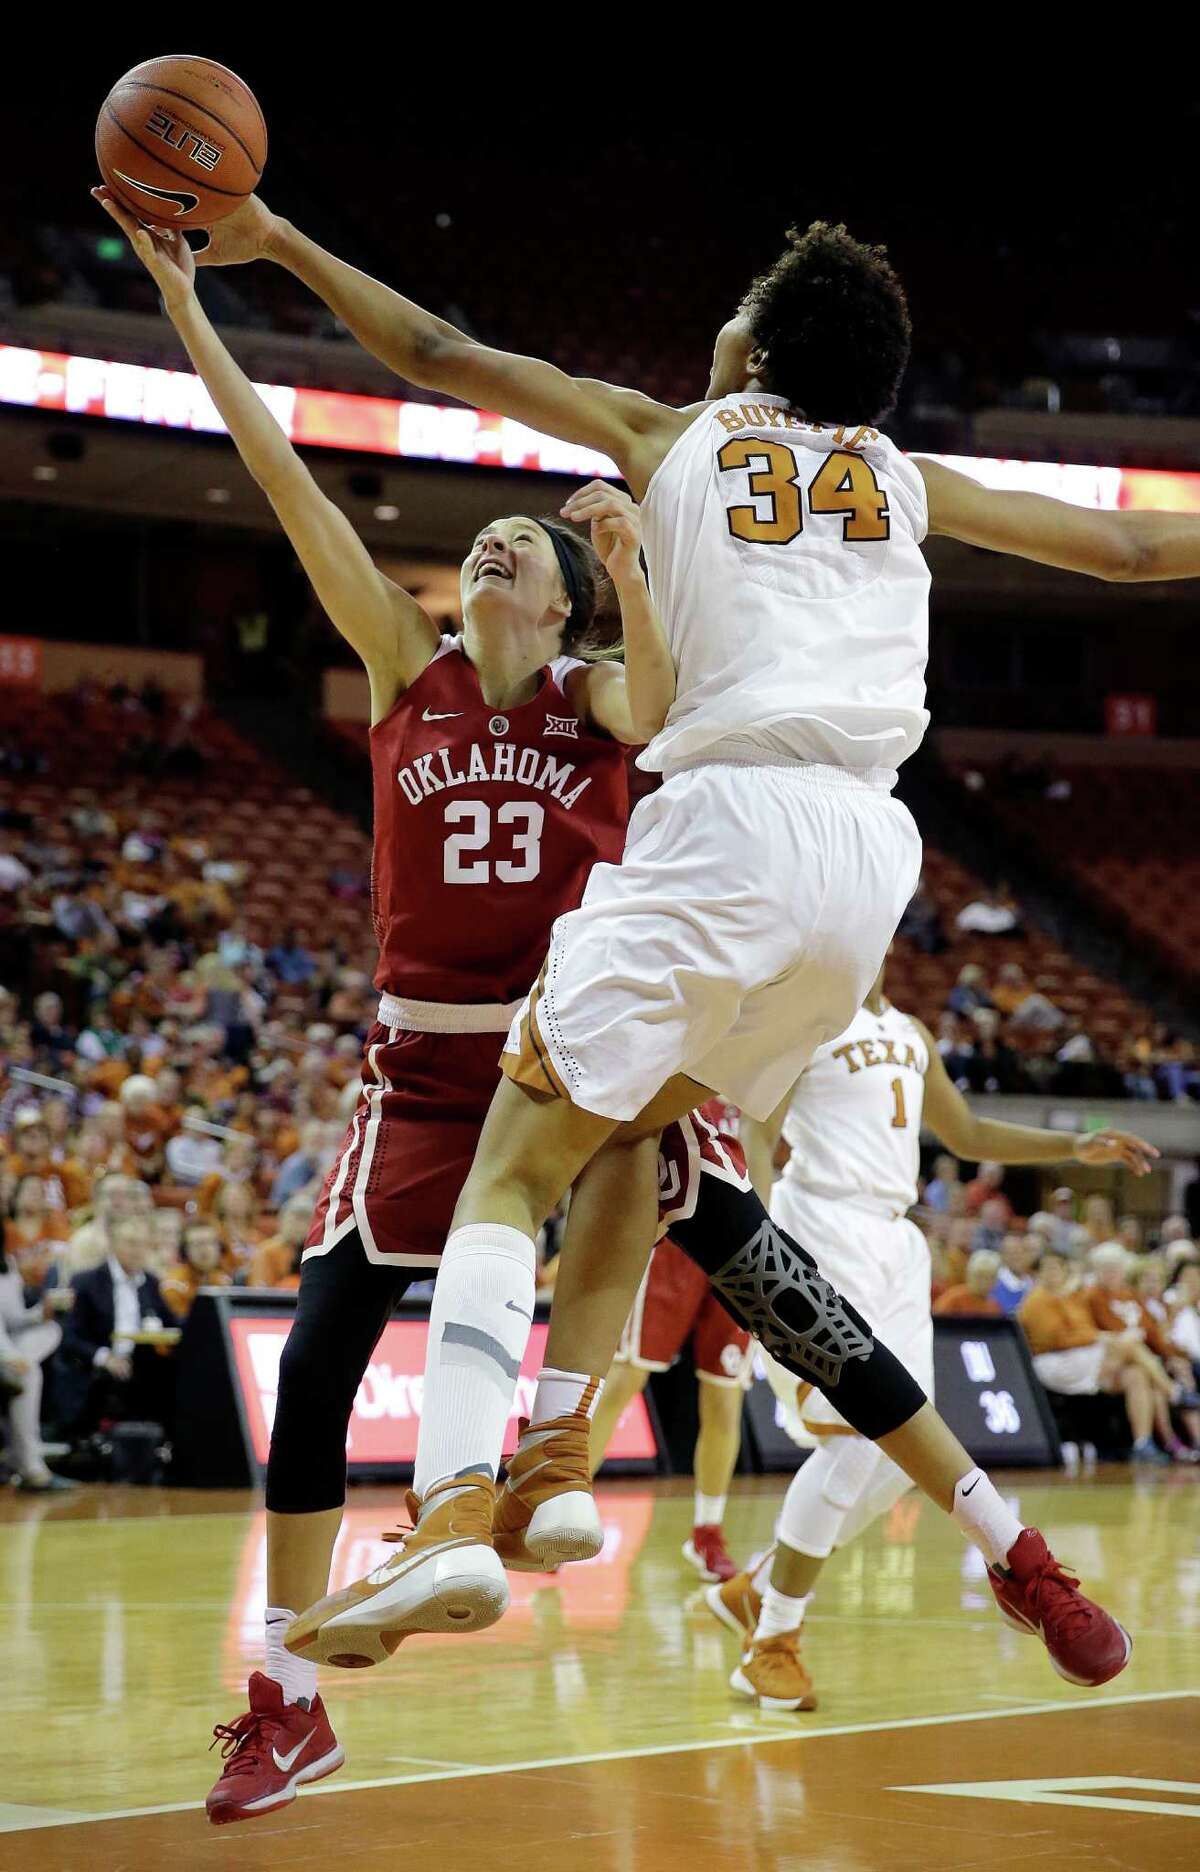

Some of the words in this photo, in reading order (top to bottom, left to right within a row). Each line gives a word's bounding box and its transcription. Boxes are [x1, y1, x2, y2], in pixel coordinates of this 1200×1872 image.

[144, 111, 223, 172] ELITE
[717, 436, 891, 545] 34
[397, 742, 593, 806] OKLAHOMA
[444, 800, 545, 884] 23
[890, 1078, 908, 1128] 1
